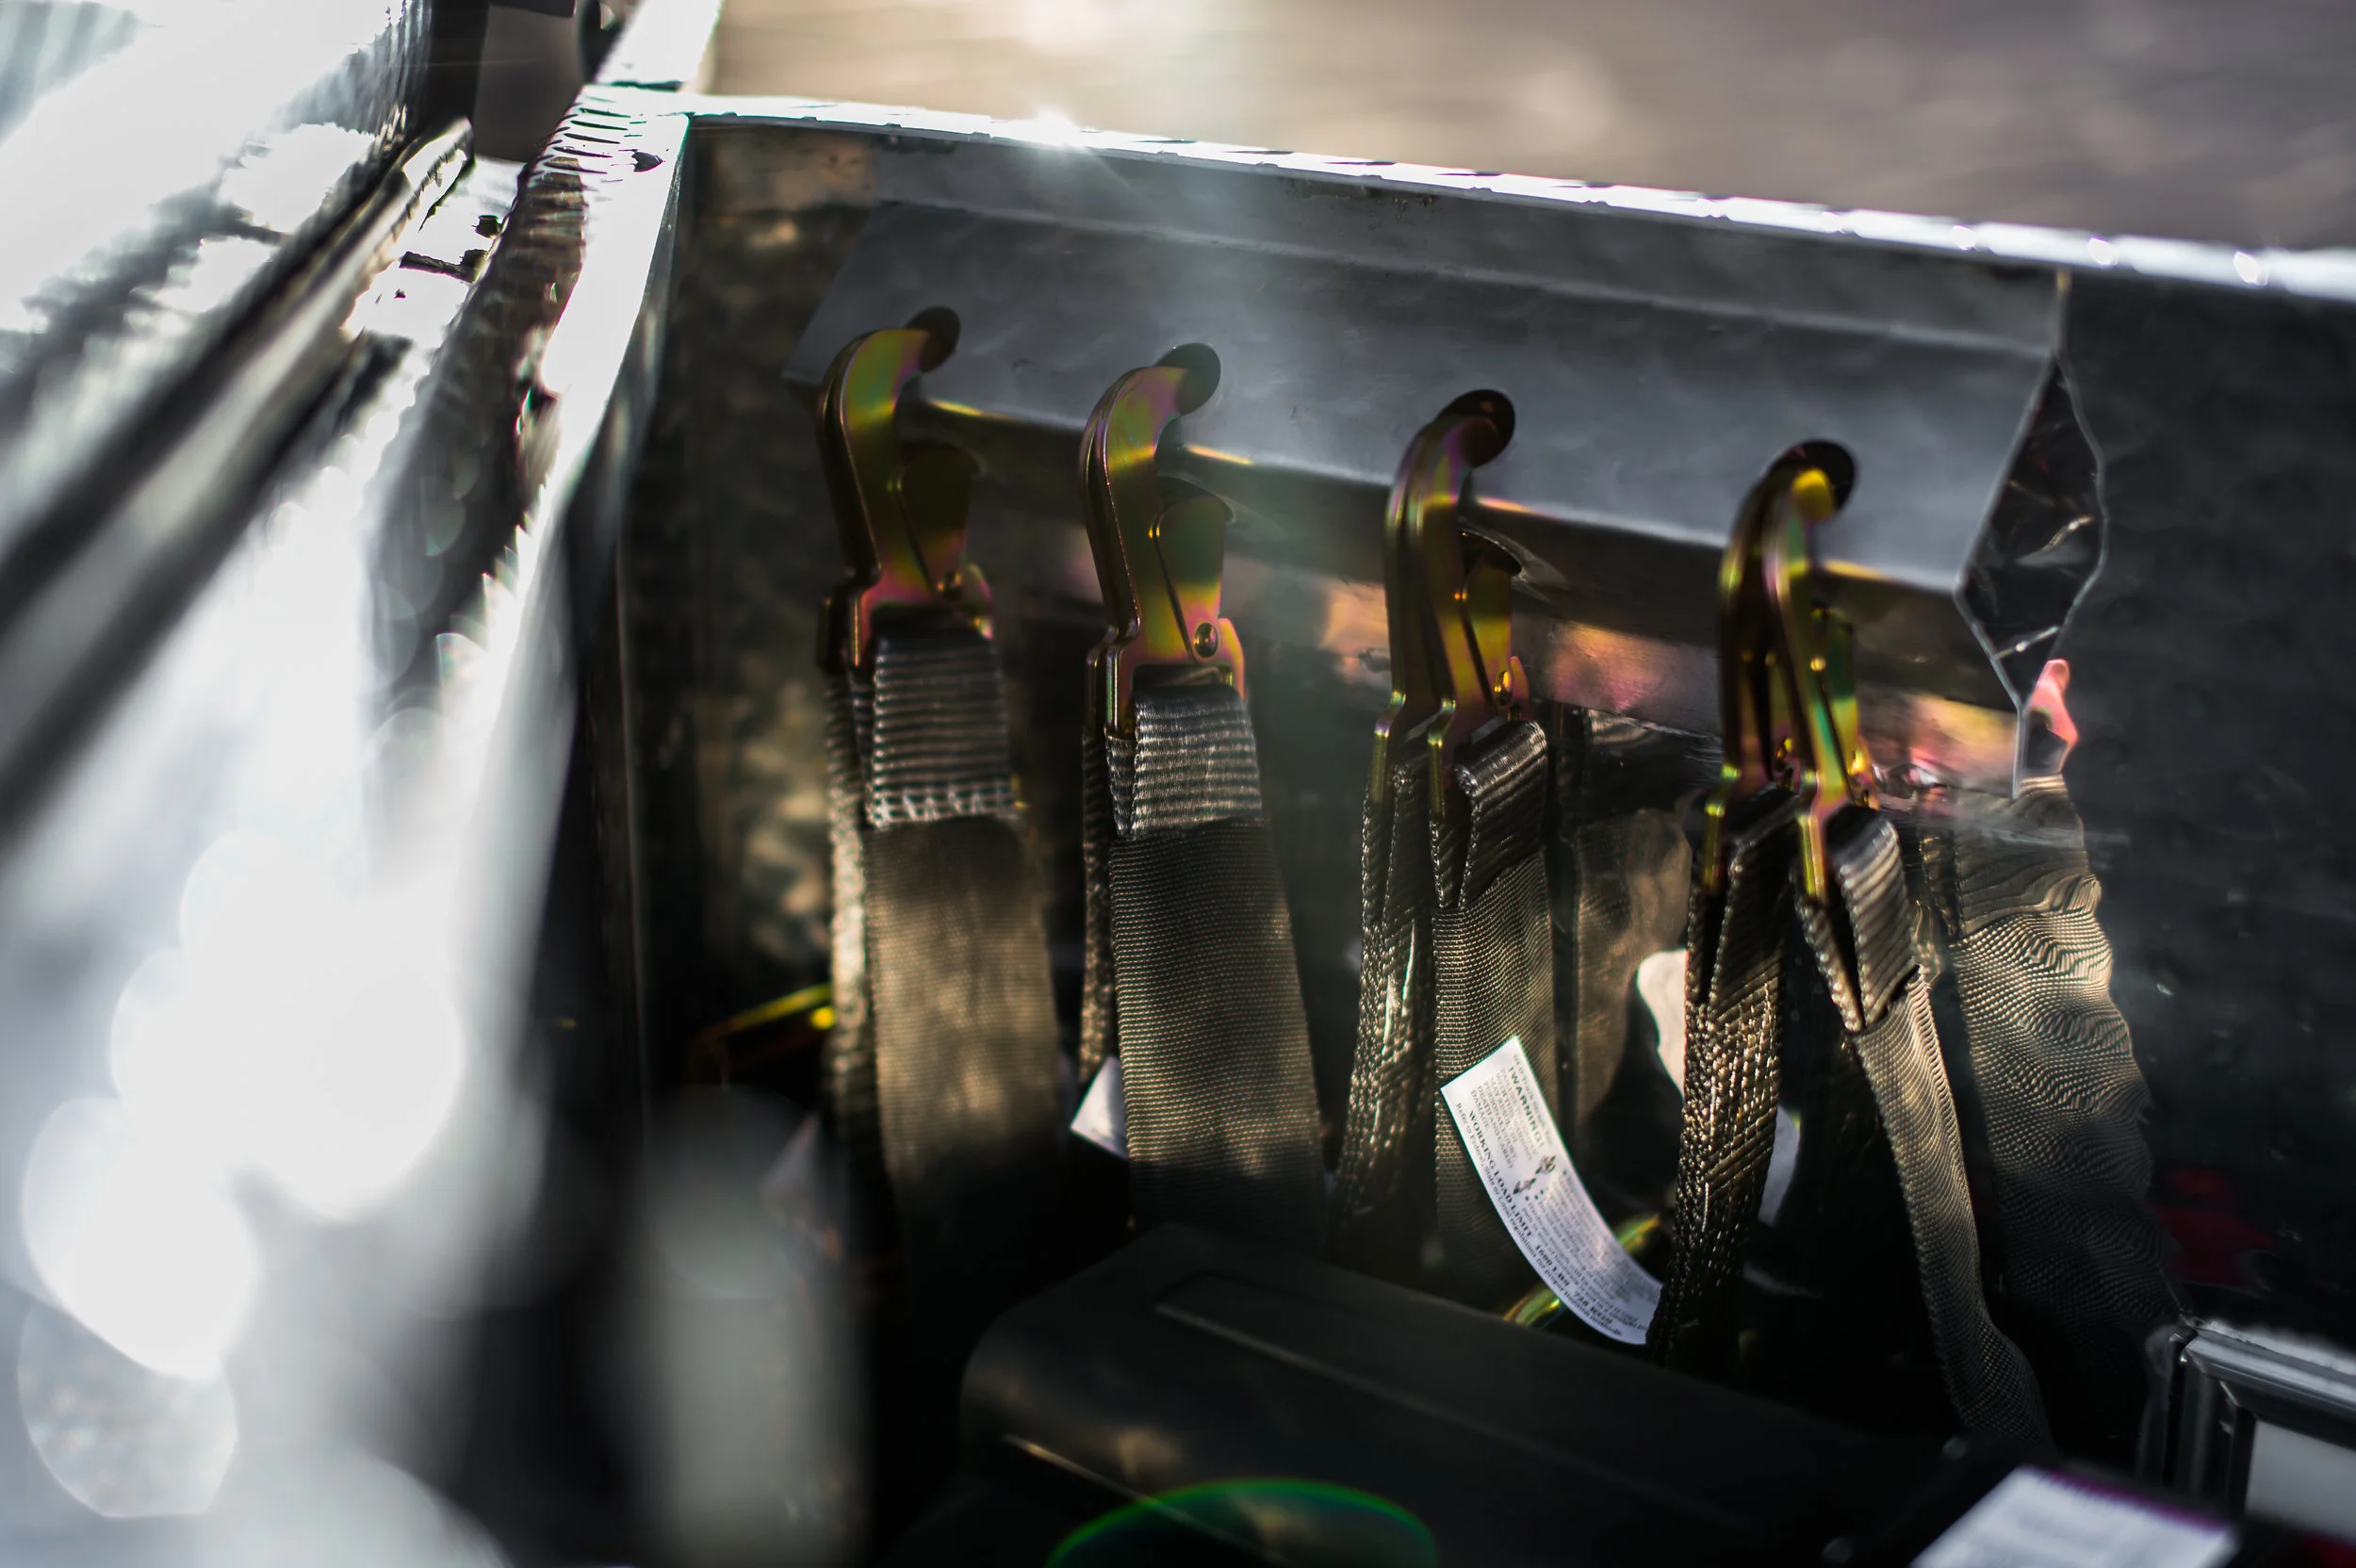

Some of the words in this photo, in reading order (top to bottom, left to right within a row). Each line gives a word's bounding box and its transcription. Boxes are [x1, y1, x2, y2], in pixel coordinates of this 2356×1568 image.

[1455, 1102, 1469, 1125] Refer
[1476, 1084, 1493, 1116] DEATH
[1488, 1114, 1500, 1136] AND
[1466, 1109, 1497, 1170] WORKING
[1493, 1168, 1513, 1204] LOAD
[1510, 1203, 1533, 1239] LIMIT
